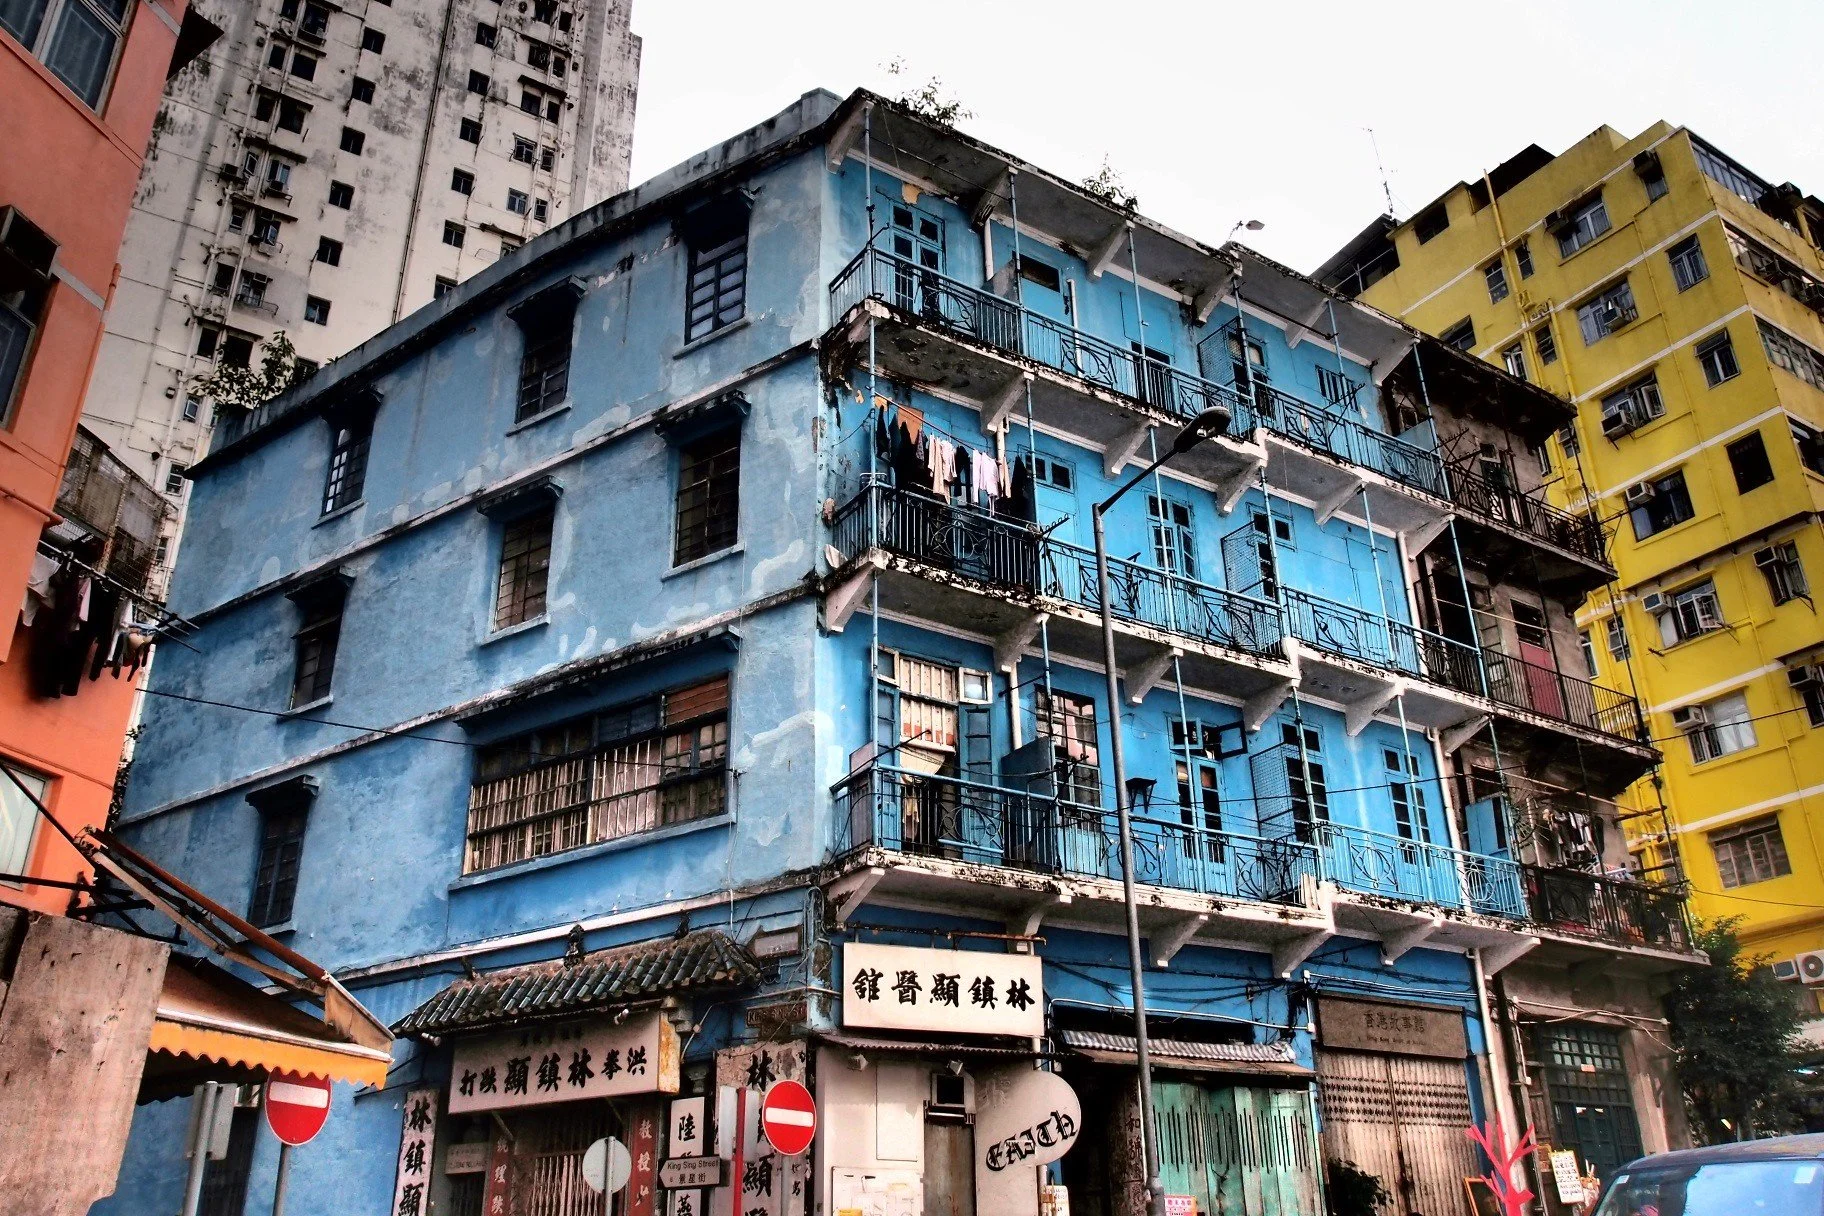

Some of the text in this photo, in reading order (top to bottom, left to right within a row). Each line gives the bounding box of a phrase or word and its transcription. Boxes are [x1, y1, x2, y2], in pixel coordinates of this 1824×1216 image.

[668, 1159, 719, 1171] King Sing Street
